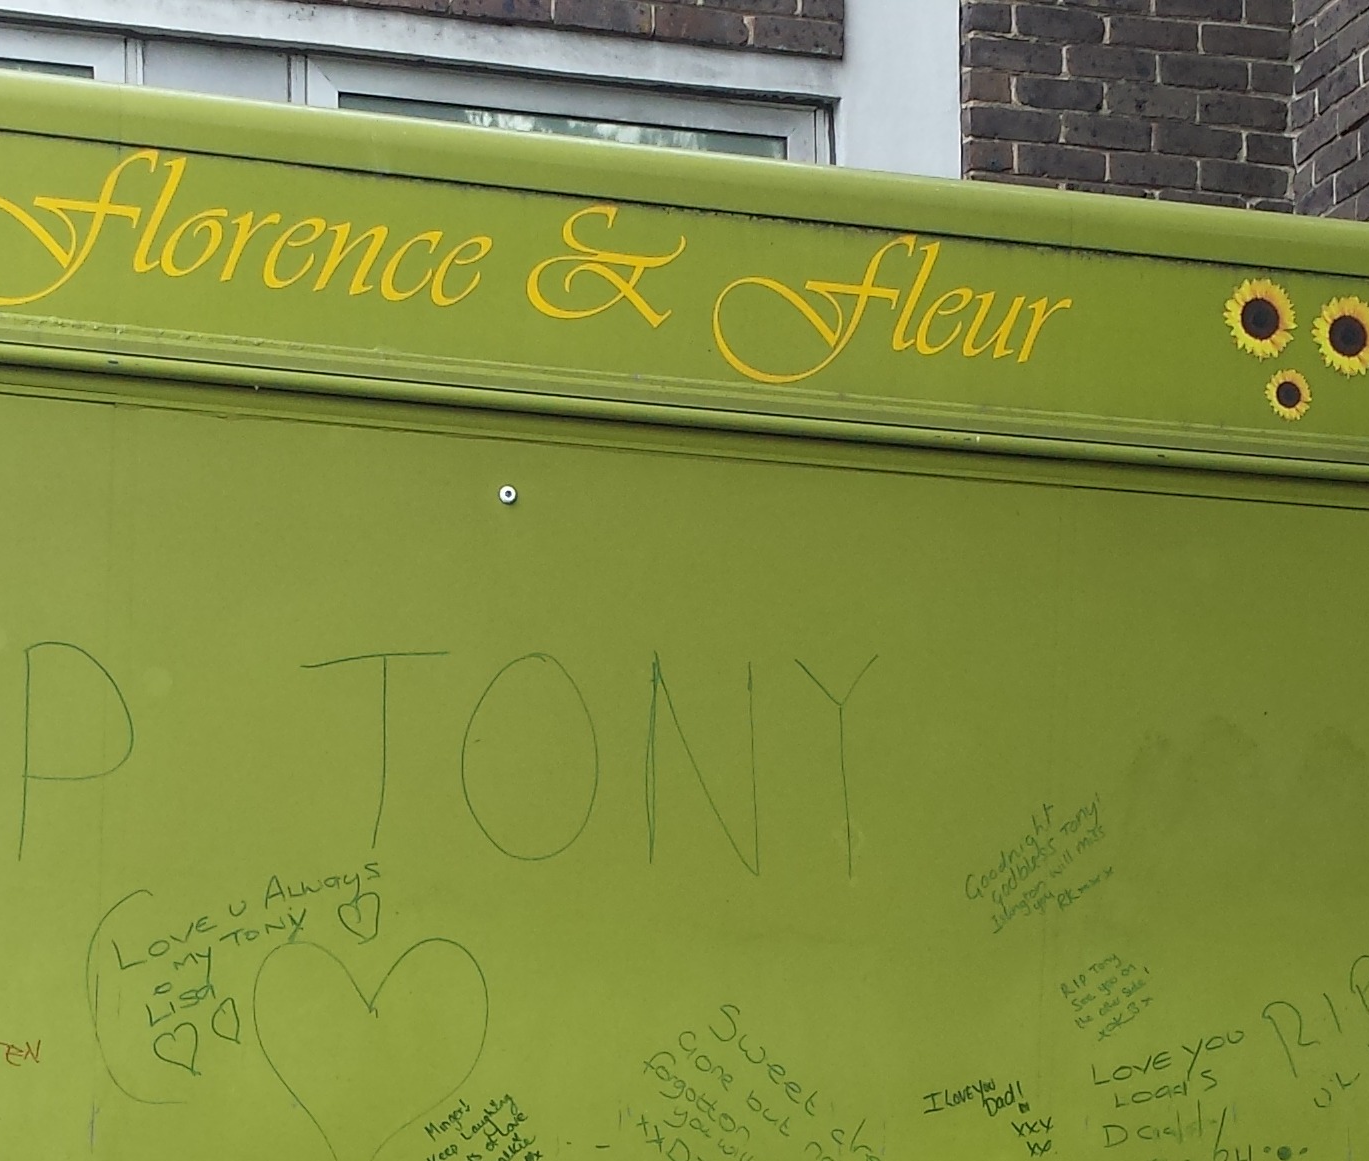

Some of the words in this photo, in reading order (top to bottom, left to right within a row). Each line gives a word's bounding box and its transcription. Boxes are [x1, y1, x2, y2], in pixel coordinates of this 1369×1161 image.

[524, 204, 688, 329] &
[712, 233, 1073, 384] Fleur
[300, 649, 880, 878] TONY
